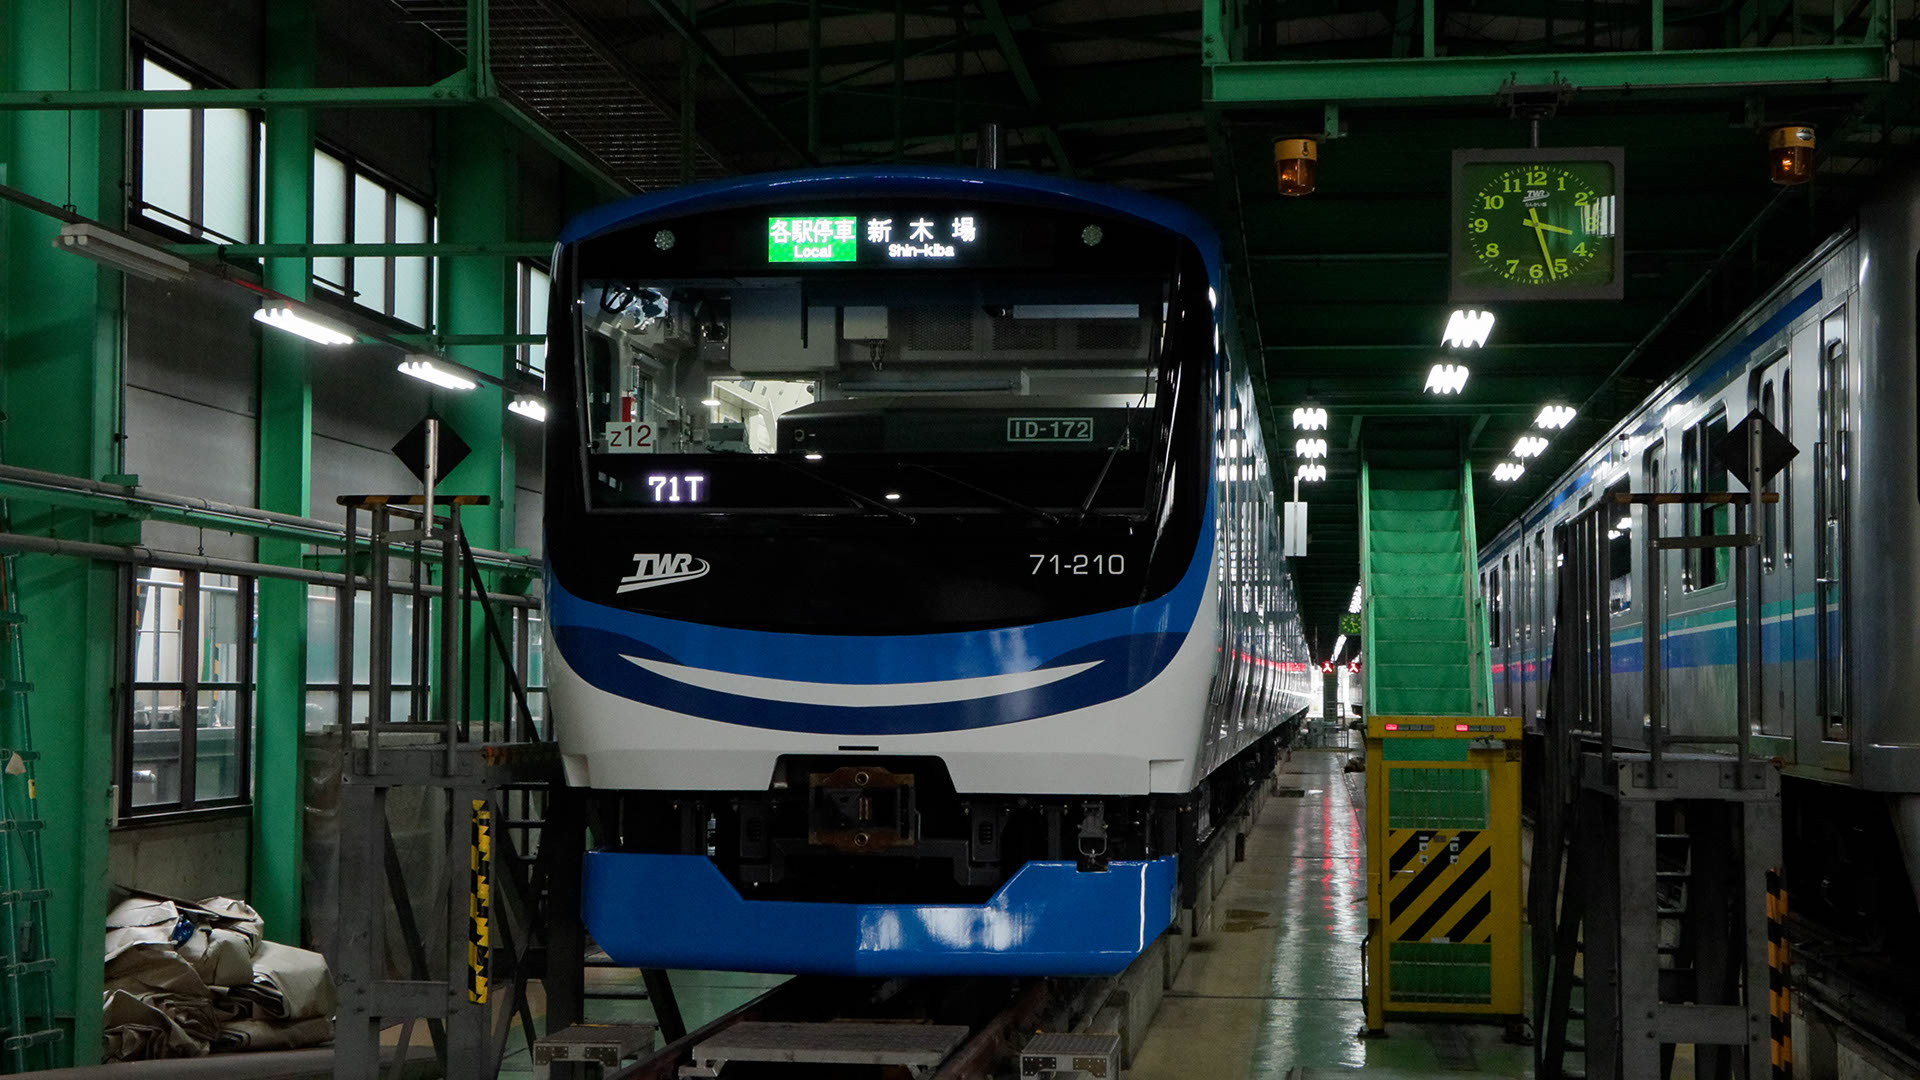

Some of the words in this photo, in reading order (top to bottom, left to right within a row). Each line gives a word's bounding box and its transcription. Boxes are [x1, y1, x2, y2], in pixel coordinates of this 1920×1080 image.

[1503, 179, 1521, 193] 11
[1525, 171, 1547, 186] 12
[1557, 177, 1566, 191] 1
[1483, 195, 1504, 210] 10
[1574, 192, 1589, 206] 2
[769, 219, 855, 243] 各駅停車
[867, 217, 976, 243] 新木場
[1474, 218, 1488, 233] 9
[794, 245, 832, 258] Local
[889, 244, 955, 257] Shin-kiba
[1485, 243, 1500, 258] 8
[1573, 242, 1588, 257] 4
[1506, 260, 1520, 274] 7
[1529, 264, 1544, 279] 6
[1554, 259, 1568, 273] 5
[1015, 421, 1089, 438] ID-172
[648, 476, 704, 501] 71T
[1029, 554, 1125, 575] 71-210
